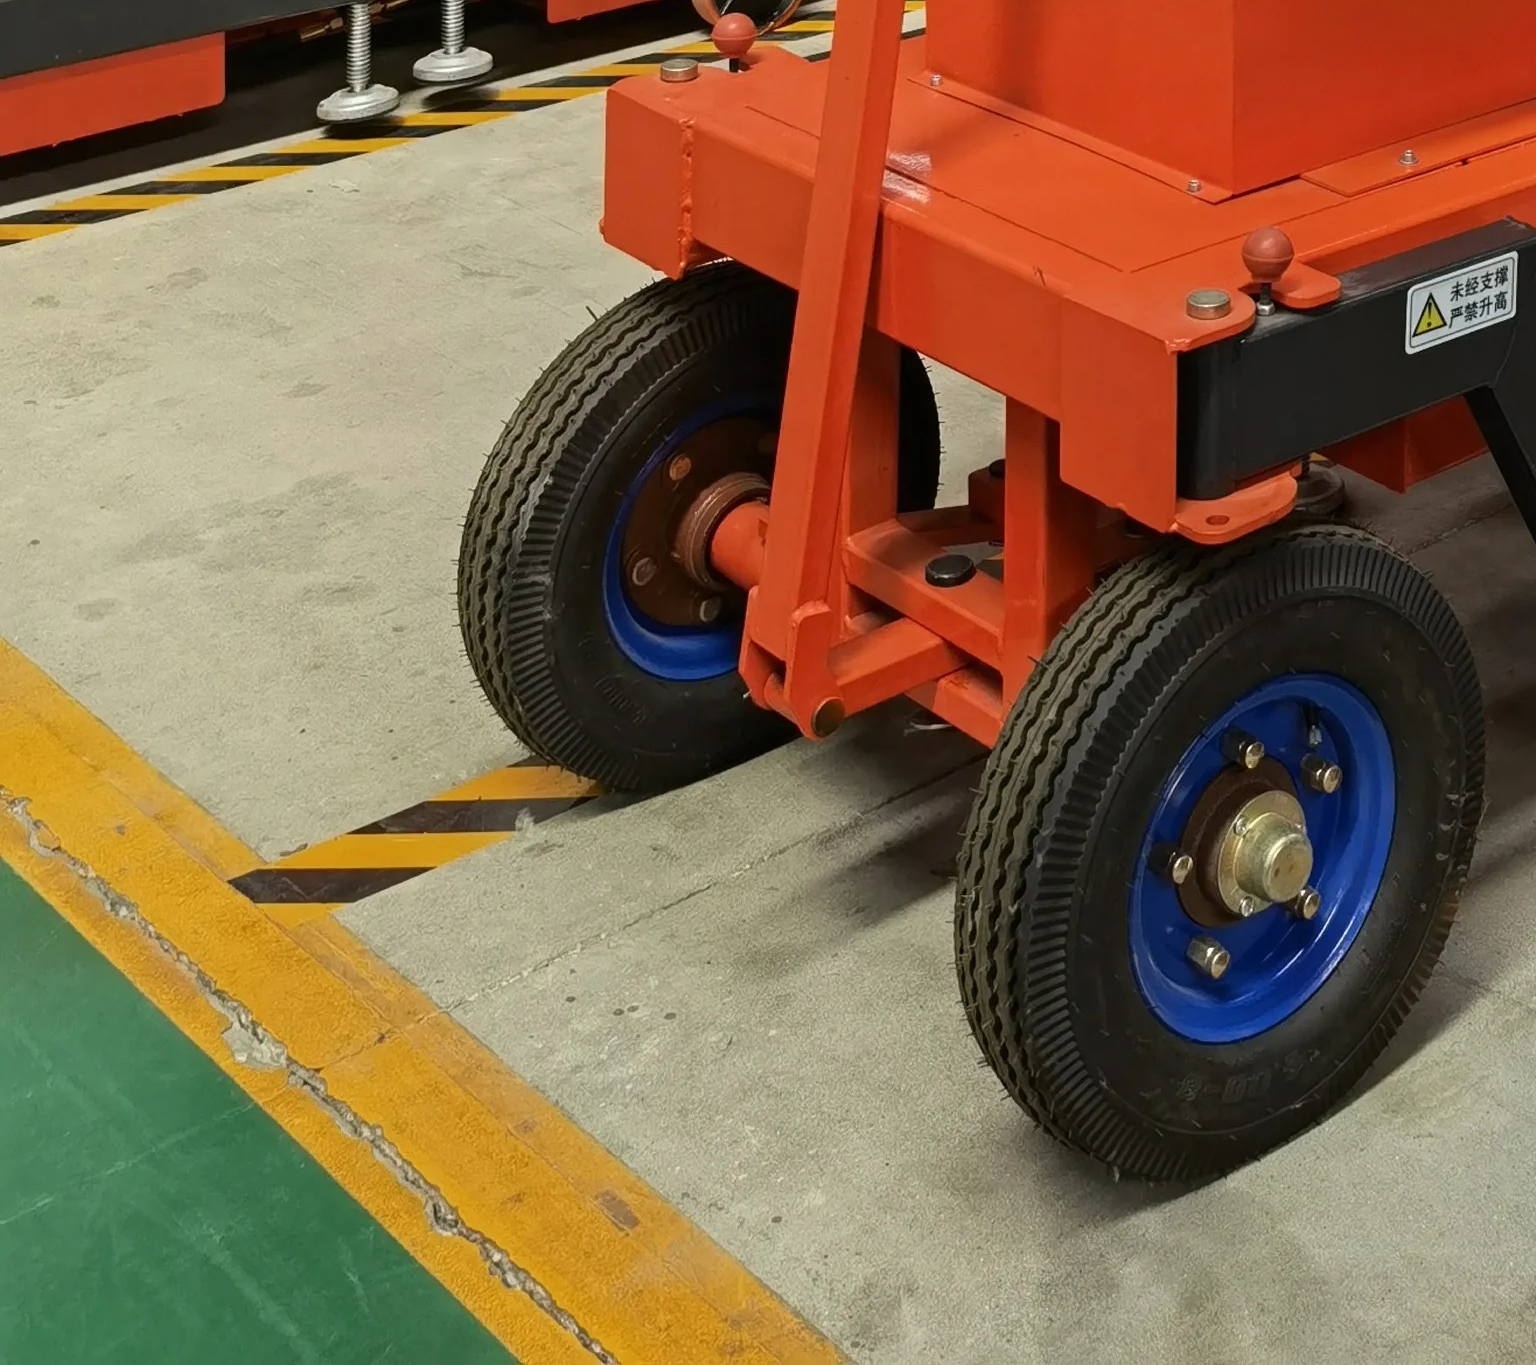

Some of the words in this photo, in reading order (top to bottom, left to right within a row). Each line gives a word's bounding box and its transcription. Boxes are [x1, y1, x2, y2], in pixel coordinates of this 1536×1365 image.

[1450, 265, 1509, 303] 未经支撑
[1448, 290, 1509, 329] 严禁升高
